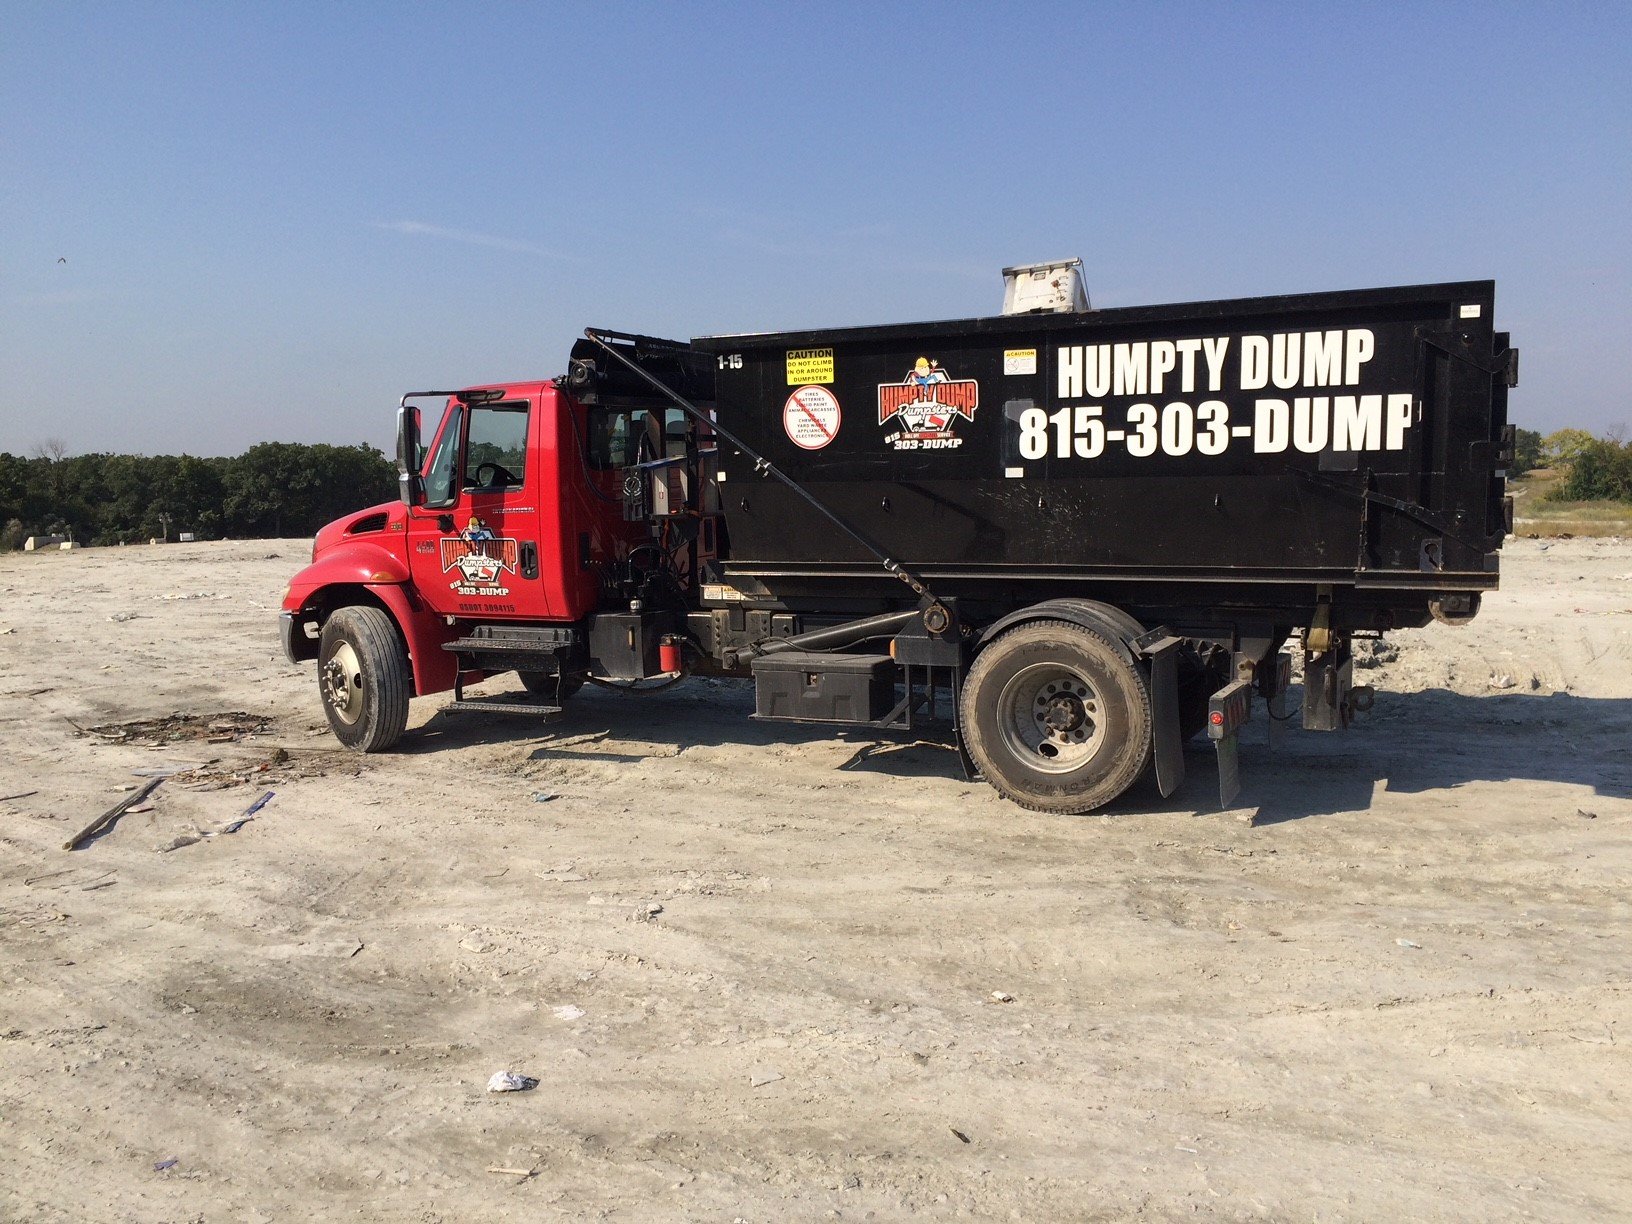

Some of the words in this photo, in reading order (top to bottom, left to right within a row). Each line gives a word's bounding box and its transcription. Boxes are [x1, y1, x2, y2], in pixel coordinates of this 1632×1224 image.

[788, 349, 832, 359] CAUTION
[717, 354, 743, 370] 1-15
[1057, 336, 1230, 399] HUMPTY
[1239, 328, 1375, 391] DUMP
[880, 384, 935, 421] HUMPTY
[936, 382, 976, 419] DUMP
[897, 403, 958, 420] Dumpsters
[1018, 393, 1422, 460] 815-303-DUMP
[884, 431, 901, 444] 815
[893, 438, 963, 450] 303-DUMP
[442, 540, 484, 570] HUMPTY
[485, 540, 516, 570] DUMP
[457, 555, 503, 570] Dumpsters
[457, 587, 509, 596] 303-DUMP
[459, 603, 482, 611] USDOT
